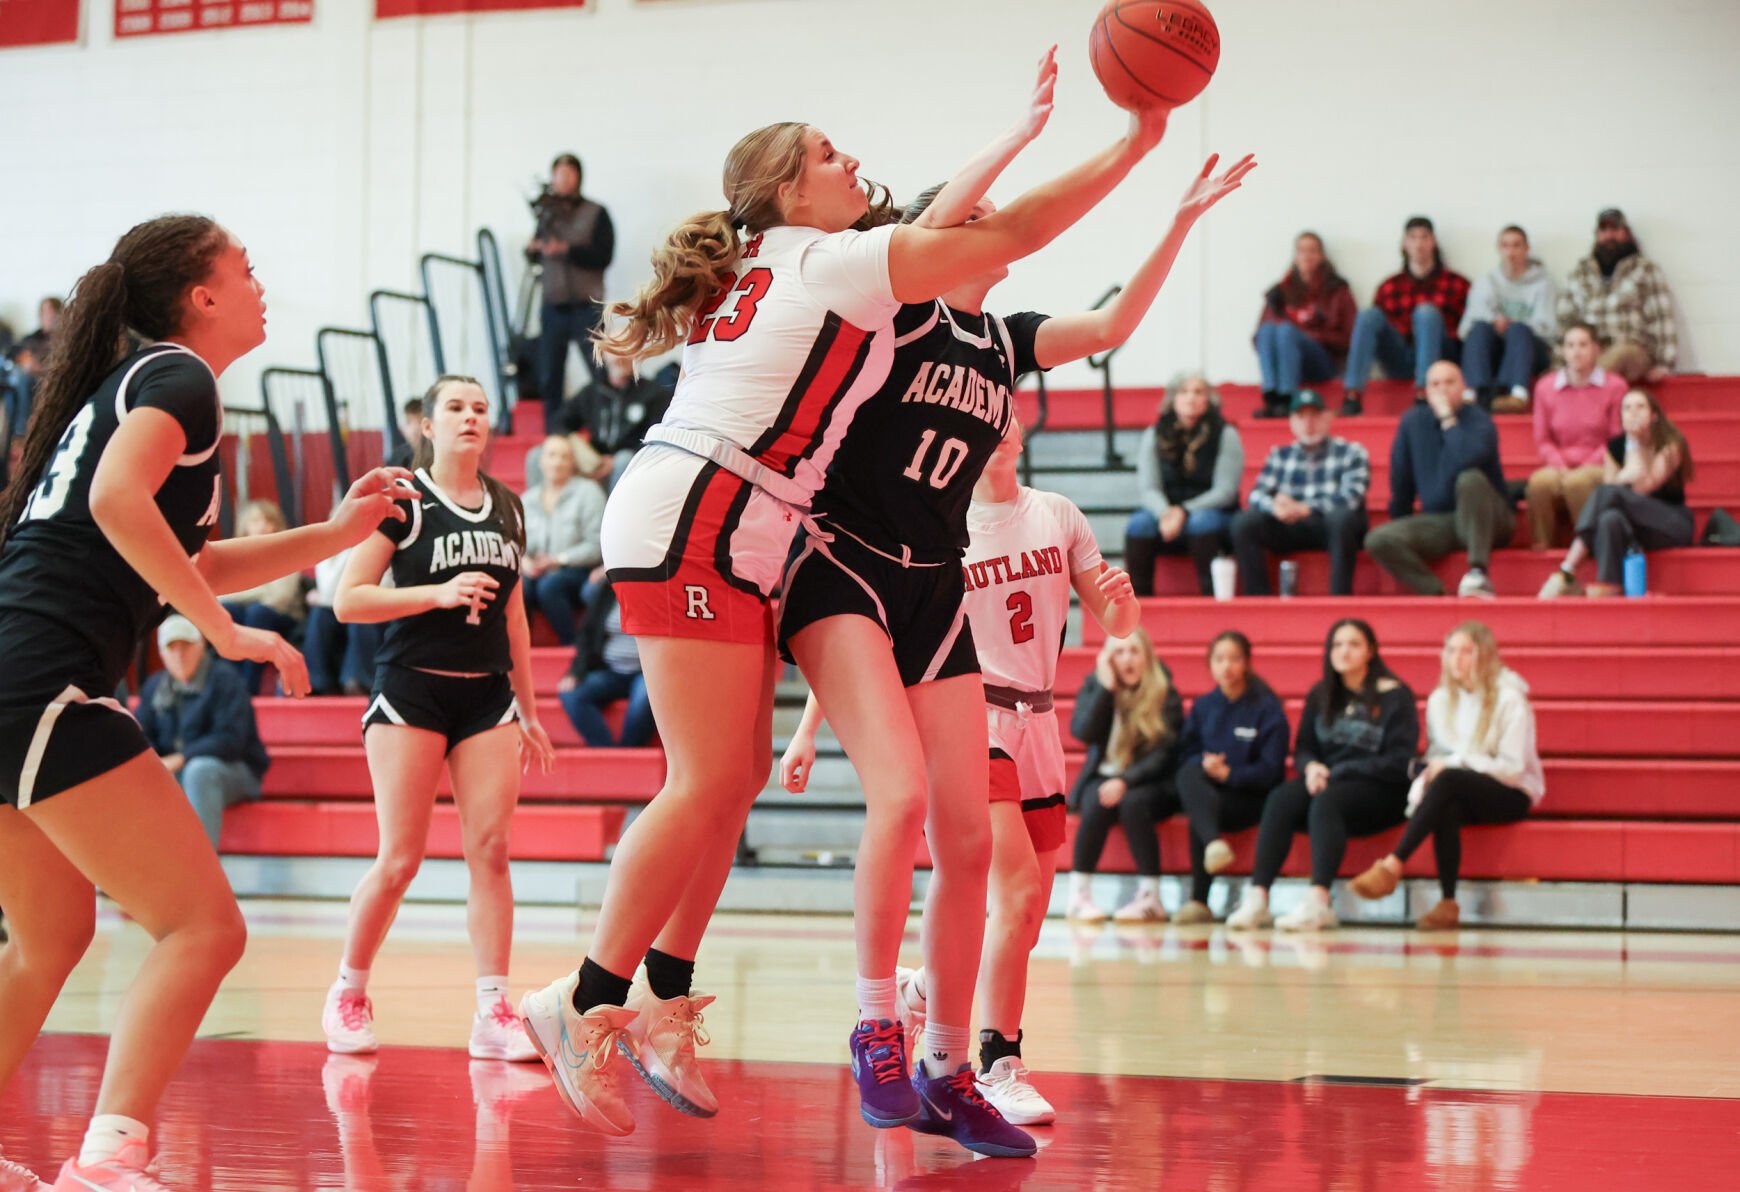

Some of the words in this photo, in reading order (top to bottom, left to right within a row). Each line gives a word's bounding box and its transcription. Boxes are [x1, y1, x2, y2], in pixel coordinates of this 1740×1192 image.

[903, 428, 970, 490] 10
[683, 583, 716, 620] R
[1006, 590, 1035, 645] 2
